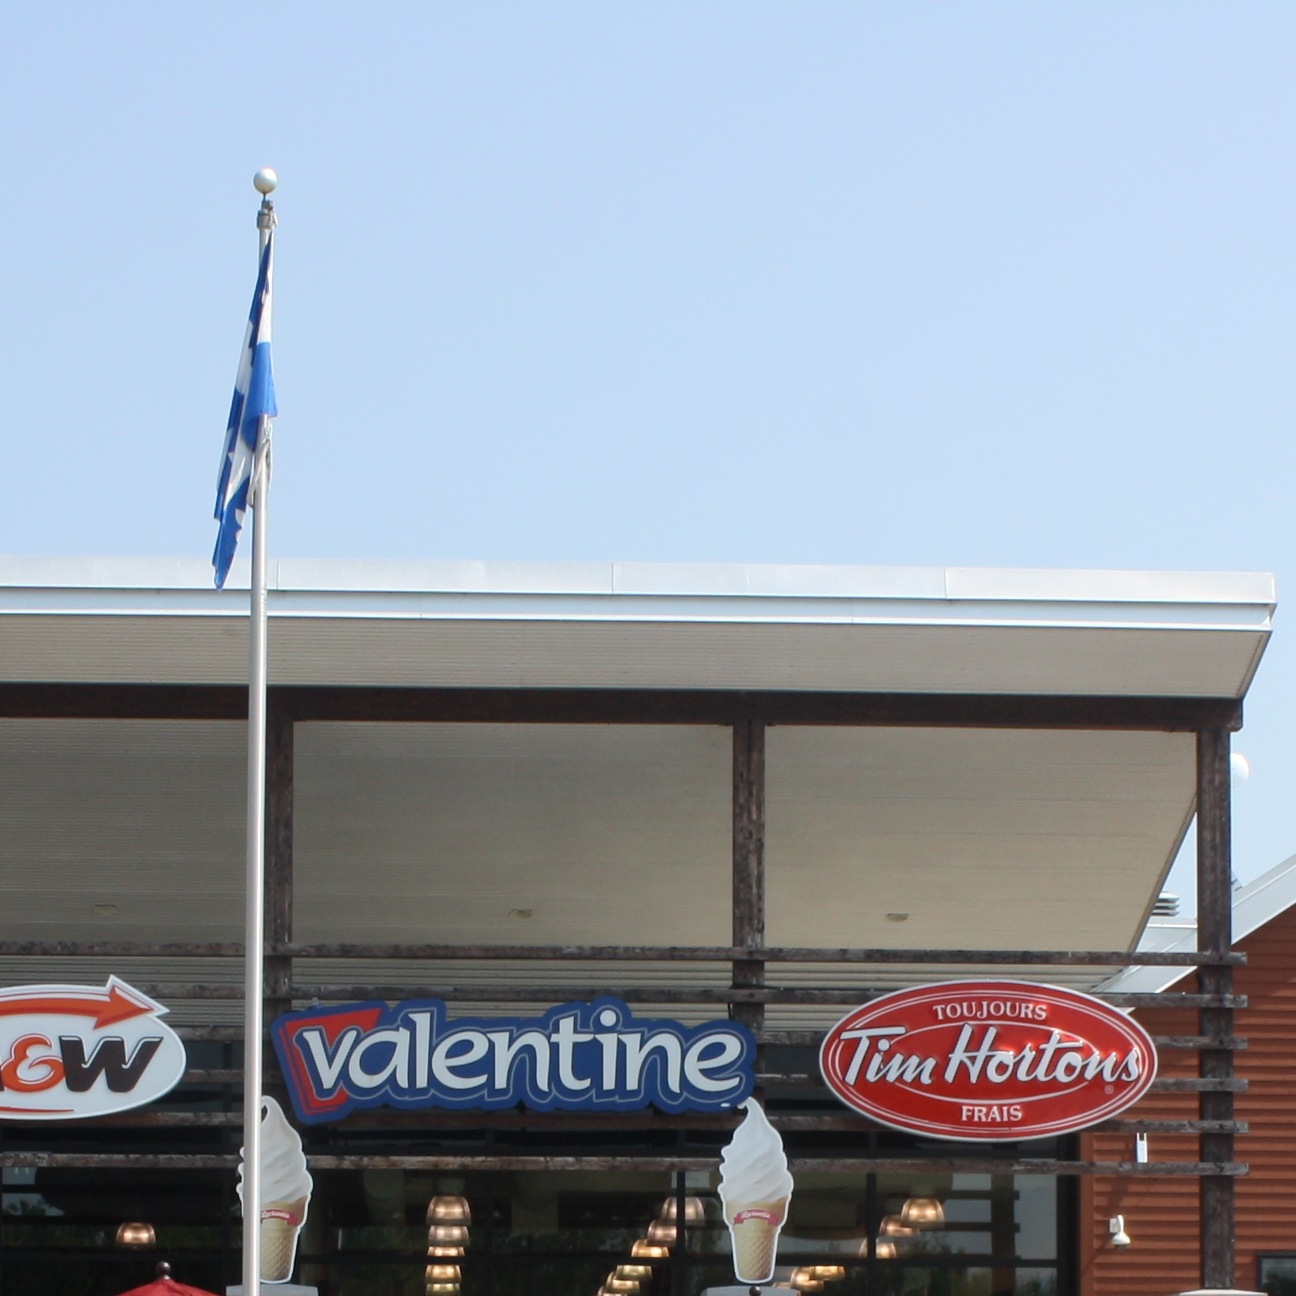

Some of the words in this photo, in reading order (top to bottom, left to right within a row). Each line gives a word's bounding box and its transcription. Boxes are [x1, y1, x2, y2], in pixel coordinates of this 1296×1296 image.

[933, 1001, 1047, 1021] TOUJOURS
[840, 1026, 938, 1086] Tim
[944, 1022, 1143, 1084] Hortons
[960, 1105, 1023, 1122] FRAIS
